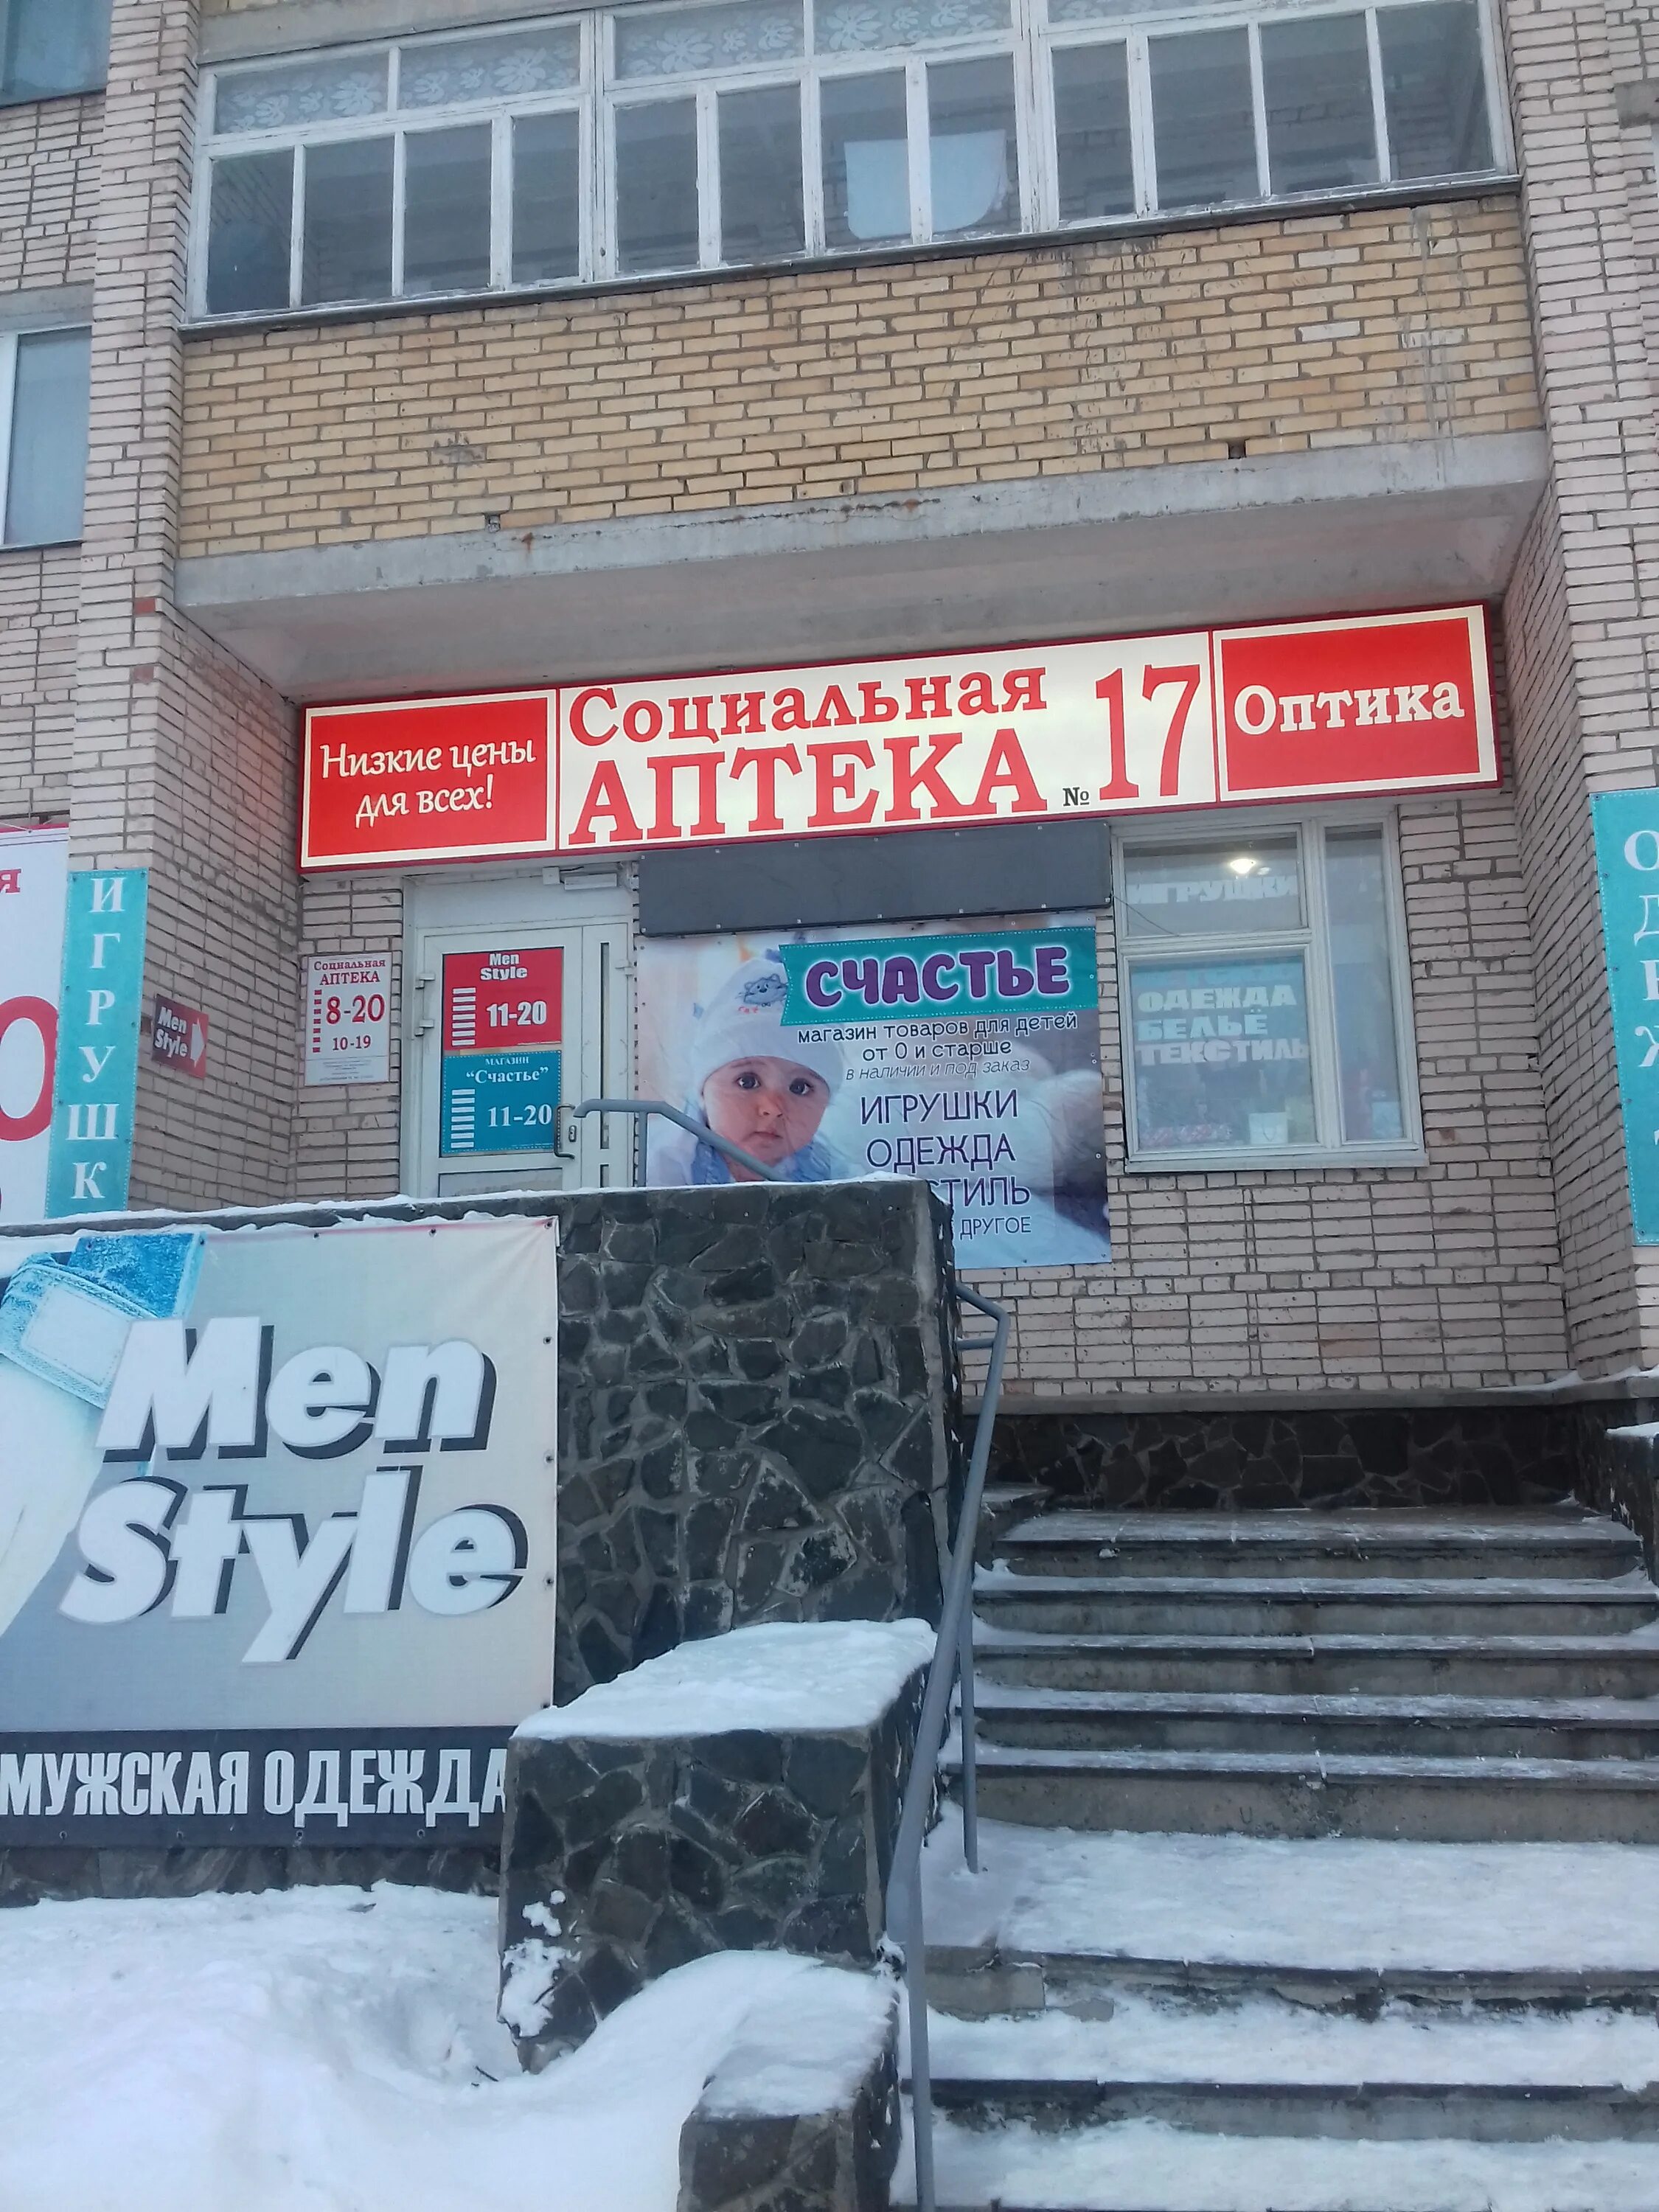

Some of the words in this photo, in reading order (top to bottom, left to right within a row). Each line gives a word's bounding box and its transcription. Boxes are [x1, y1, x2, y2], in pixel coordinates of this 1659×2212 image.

[568, 667, 1047, 747] Социальная
[1234, 681, 1465, 735] Оптика
[319, 742, 442, 779] Низкие
[449, 739, 537, 777] цены
[568, 728, 1048, 845] АПТЕКА
[1096, 664, 1200, 801] 17
[355, 794, 411, 829] для
[417, 774, 495, 813] всех!
[313, 959, 386, 971] Социальная
[480, 966, 528, 981] Style
[490, 953, 520, 966] Men
[319, 970, 380, 986] АПТЕКА
[805, 945, 1072, 1010] СЧАСТЬЕ
[326, 993, 386, 1025] 8-20
[1137, 984, 1298, 1012] ОДЕЖДА
[158, 1006, 187, 1034] Men
[486, 1000, 547, 1027] 11-20
[798, 1027, 877, 1044] магазин
[883, 1019, 968, 1041] товаров
[974, 1017, 1010, 1034] для
[1015, 1011, 1078, 1035] детей
[154, 1029, 188, 1058] Style
[332, 1034, 372, 1051] 10-19
[862, 1047, 887, 1062] от
[915, 1046, 926, 1059] и
[932, 1040, 1012, 1060] старше
[1135, 1038, 1310, 1066] ТЕКСТИЛЬ
[485, 1057, 529, 1065] МАГАЗИН
[846, 1068, 854, 1080] в
[859, 1062, 926, 1079] наличии
[930, 1064, 940, 1075] и
[944, 1062, 978, 1077] под
[982, 1059, 1031, 1073] заказ
[487, 1104, 552, 1127] 11-20
[860, 1089, 1019, 1125] ИГРУШКИ
[866, 1133, 1016, 1174] ОДЕЖДА
[960, 1217, 1032, 1240] ДРУГОЕ
[95, 1315, 497, 1463] Men
[58, 1464, 529, 1663] Style
[0, 1750, 250, 1816] МУЖСКАЯ
[264, 1747, 508, 1828] ОДЕЖДА
